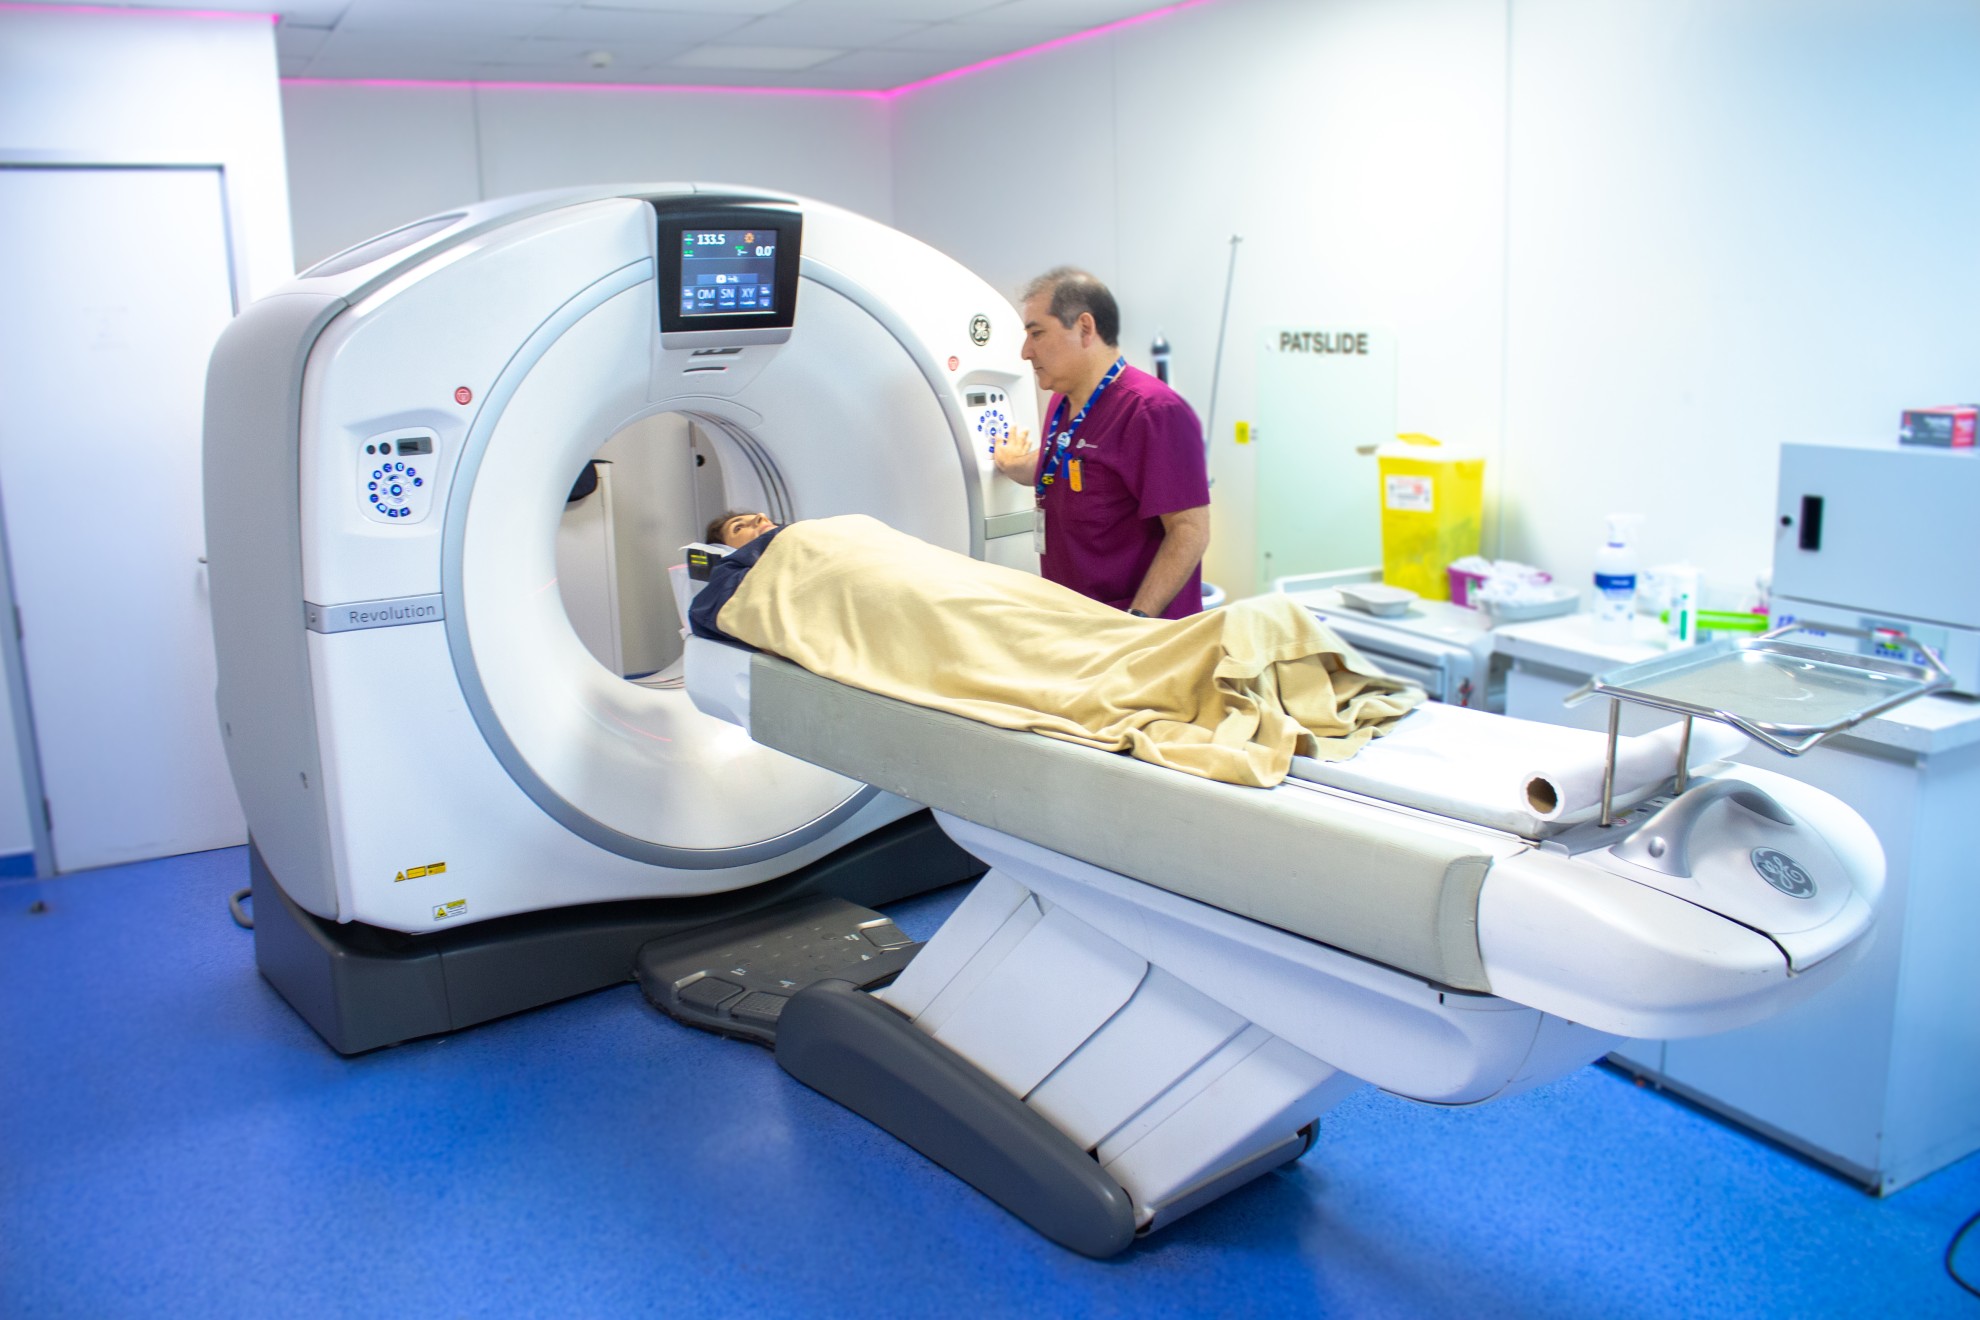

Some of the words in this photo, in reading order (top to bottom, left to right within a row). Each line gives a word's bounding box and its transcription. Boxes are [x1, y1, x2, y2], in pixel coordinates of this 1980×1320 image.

[720, 288, 735, 299] SN
[741, 287, 756, 298] XY
[1280, 331, 1368, 355] PATSLIDE
[349, 604, 436, 624] Revolution
